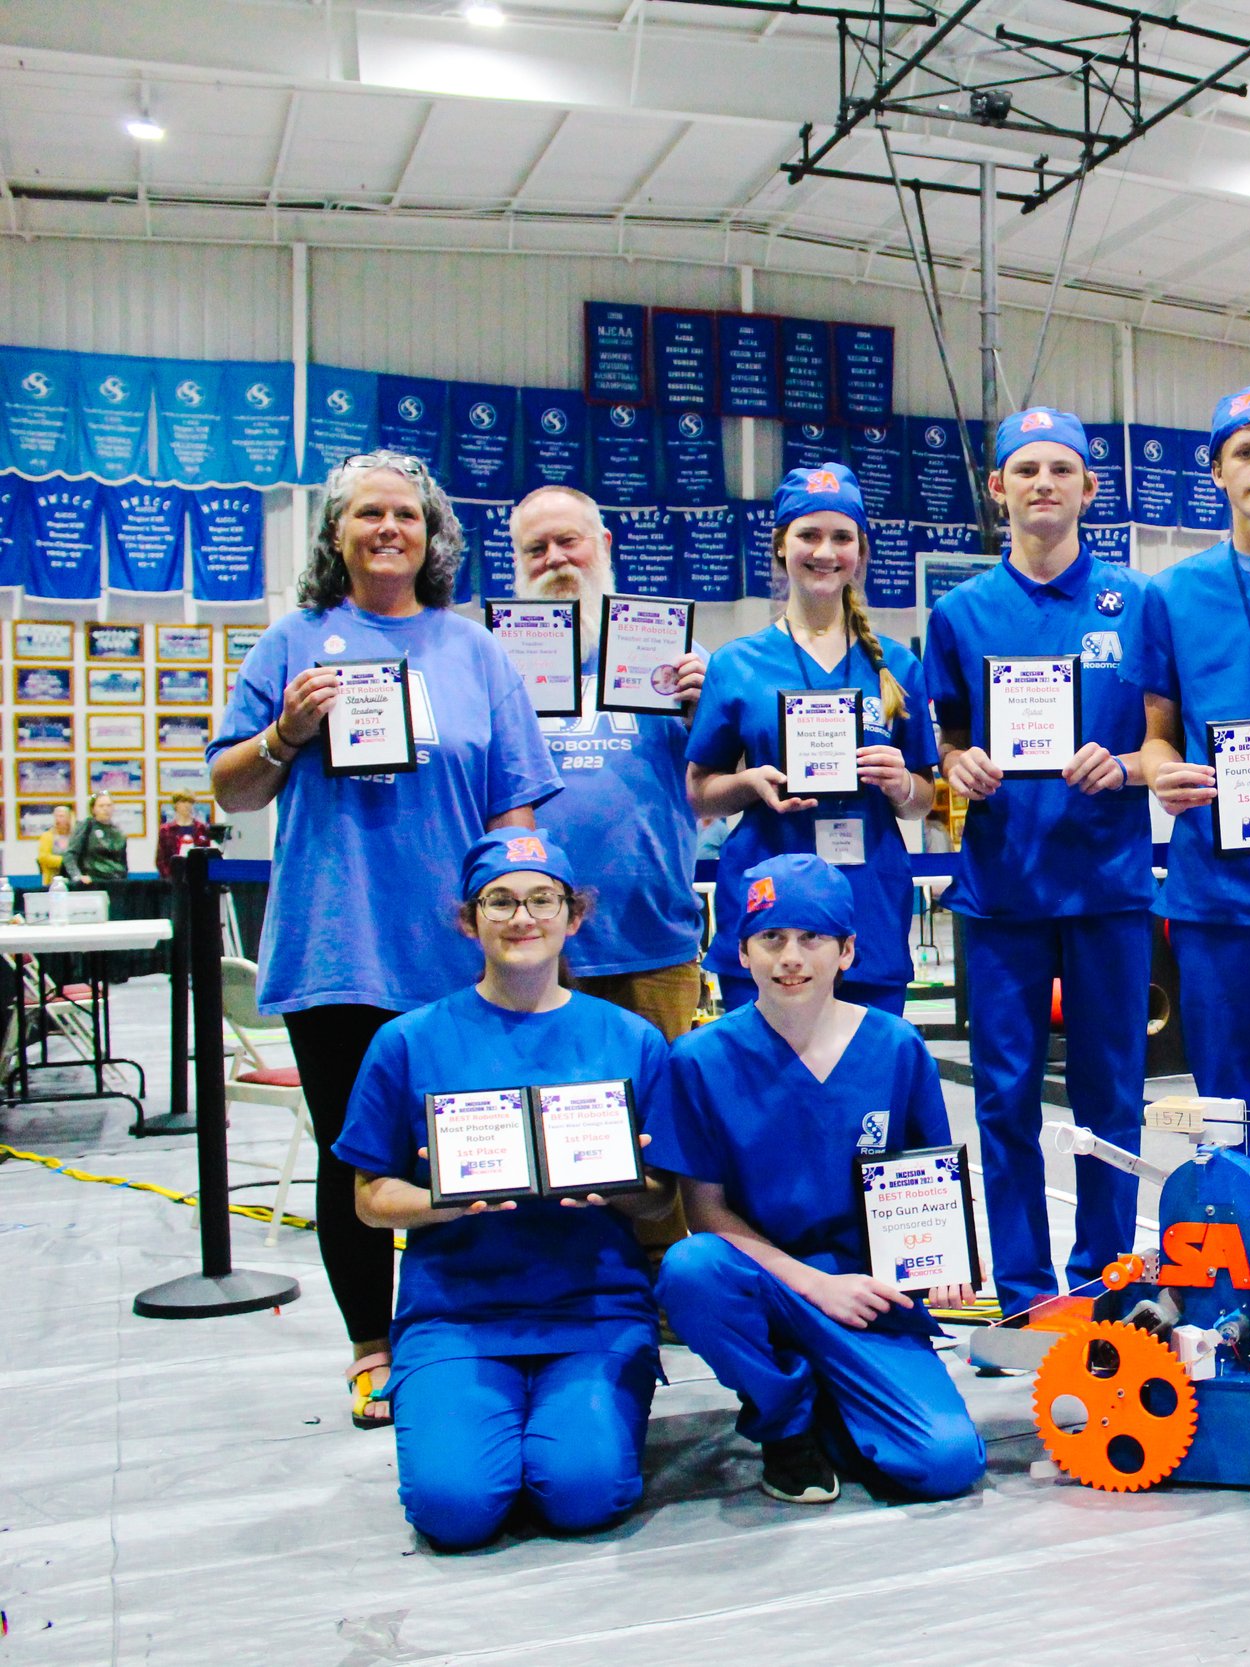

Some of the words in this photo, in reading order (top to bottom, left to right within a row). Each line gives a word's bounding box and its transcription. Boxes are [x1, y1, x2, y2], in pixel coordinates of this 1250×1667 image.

[598, 326, 633, 337] NJCAA
[1102, 592, 1118, 611] R
[501, 630, 523, 638] BEST
[526, 630, 565, 638] Robotics
[618, 623, 639, 632] BEST
[641, 625, 678, 635] Robotics
[358, 685, 394, 694] Robotics
[1004, 686, 1024, 694] BEST
[1026, 685, 1060, 693] Robotics
[1029, 696, 1057, 704] Robust
[1011, 722, 1025, 730] 1st
[1028, 721, 1055, 730] Place
[818, 730, 847, 739] Elegant
[810, 740, 834, 748] Robot
[1020, 739, 1052, 748] BEST
[562, 755, 604, 770] 2023
[1228, 753, 1250, 763] BEST
[811, 762, 840, 770] BEST
[449, 1114, 470, 1122] BEST
[472, 1113, 510, 1121] Robotics
[551, 1112, 574, 1121] BEST
[577, 1110, 620, 1119] Robotics
[1155, 1111, 1192, 1128] 1571
[440, 1126, 464, 1134] Most
[466, 1121, 519, 1132] Photogenic
[466, 1134, 495, 1142] Robot
[564, 1135, 579, 1143] 1st
[582, 1133, 610, 1142] Place
[457, 1148, 474, 1157] 1st
[476, 1146, 507, 1156] Place
[469, 1159, 504, 1169] BEST
[896, 1169, 926, 1179] INCISION
[889, 1178, 918, 1188] DECISION
[920, 1176, 934, 1185] 2023
[878, 1191, 903, 1202] BEST
[905, 1187, 948, 1199] Robotics
[871, 1208, 893, 1220] Top
[895, 1205, 919, 1216] Gun
[922, 1200, 958, 1213] Award
[882, 1219, 933, 1232] sponsored
[935, 1217, 947, 1227] by
[904, 1231, 932, 1249] igus
[905, 1254, 944, 1269] BEST
[909, 1268, 944, 1278] ROBOTICS
